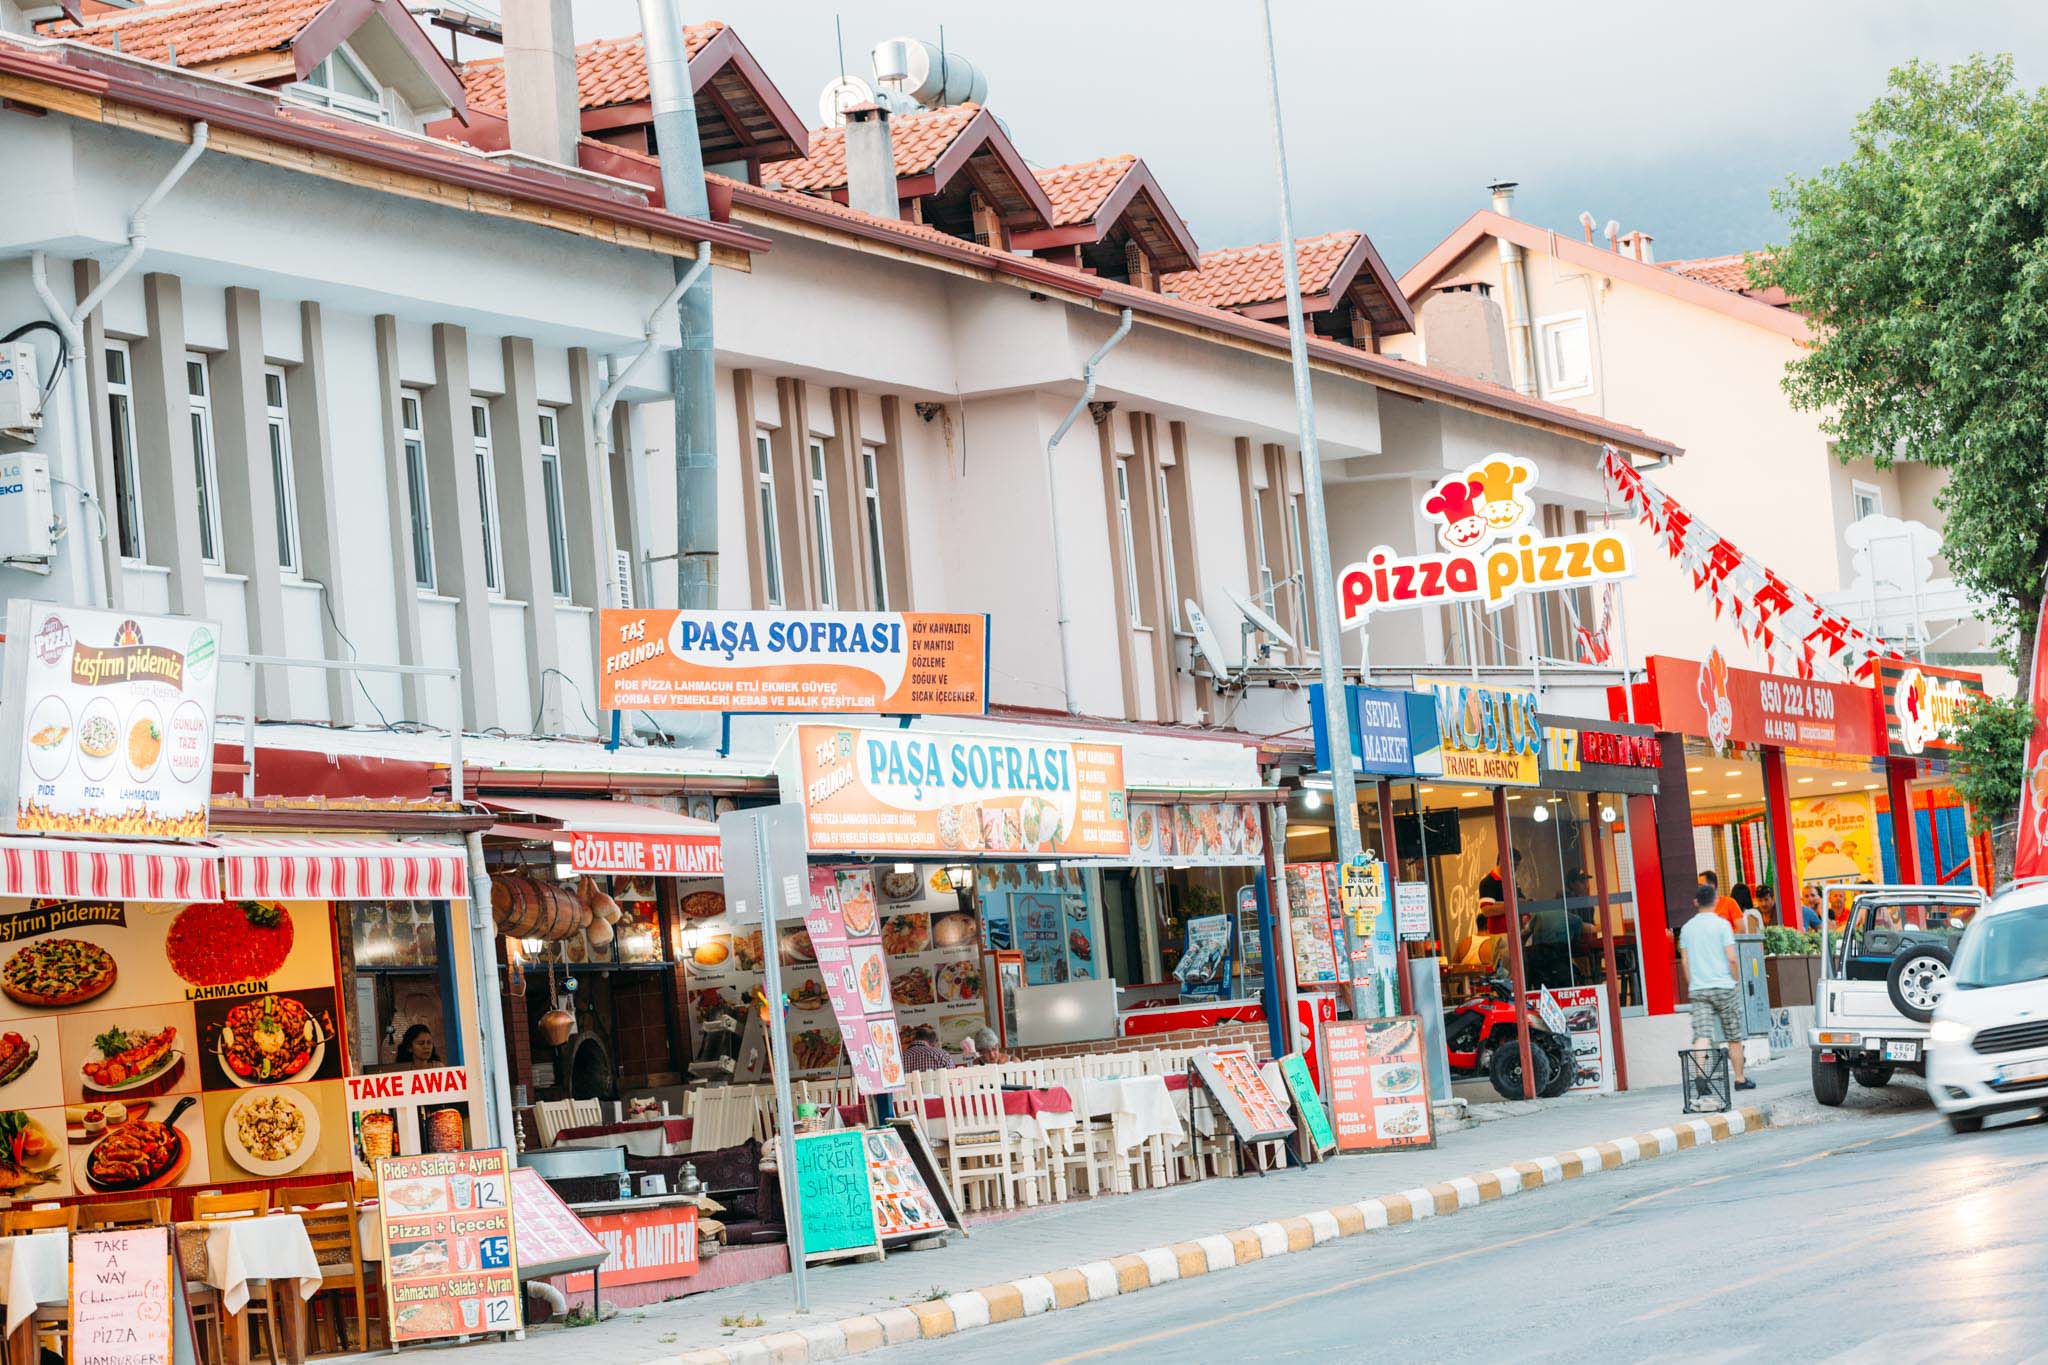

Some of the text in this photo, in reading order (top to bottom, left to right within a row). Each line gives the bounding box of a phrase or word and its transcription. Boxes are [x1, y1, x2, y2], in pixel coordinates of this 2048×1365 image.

[4, 467, 20, 477] LG
[1342, 534, 1626, 620] pizza pizza
[620, 619, 647, 644] TAŞ
[681, 620, 901, 661] PAŞA SOFRASI
[912, 622, 972, 635] KÖY KAHVALTISI
[606, 637, 666, 675] FIRINDA
[912, 639, 955, 652] EV MANTISI
[74, 651, 125, 686] taşfırın
[127, 648, 182, 681] pidemiz
[912, 655, 946, 669] GÖZLEME
[614, 679, 838, 696] PİDE PİZZA LAHMACUN ETLİ EKMEK GÜVEÇ
[912, 671, 949, 685] SOĞUK VE
[614, 693, 876, 709] ÇORBA EV YEMEKLERİ KEBAB VE BALIK ÇEŞİTLERİ
[911, 690, 934, 702] SICAK
[1760, 680, 1834, 720] 850 222 4 500
[1365, 700, 1402, 729] SEVDA
[1765, 718, 1774, 739] 44
[1774, 719, 1783, 740] 44
[1783, 721, 1796, 742] 500
[1363, 734, 1409, 765] MARKET
[868, 739, 1070, 800] PAŞA SOFRASI
[1444, 755, 1519, 779] TRAVEL AGENCY
[119, 788, 161, 801] LAHMACUN
[808, 762, 855, 807] FIRINDA
[1828, 814, 1865, 828] pizza
[574, 834, 645, 869] GÖZLEME
[651, 843, 672, 871] EV
[1345, 885, 1379, 898] TAXI
[50, 901, 121, 929] pidemiz
[185, 980, 269, 1001] LAHMACUN
[1558, 990, 1581, 999] RENT
[1579, 996, 1597, 1005] CAR
[1380, 1055, 1406, 1064] 12 TL
[349, 1070, 467, 1100] TAKE AWAY
[1399, 1096, 1410, 1104] TL
[1405, 1136, 1416, 1144] TL
[383, 1160, 408, 1180] Pide
[420, 1158, 457, 1176] Salata
[469, 1154, 501, 1175] Ayran
[797, 1147, 854, 1173] HICKEN
[474, 1181, 498, 1209] 12
[806, 1173, 862, 1198] SHISH
[388, 1220, 431, 1240] Pizza
[449, 1215, 507, 1237] İçecek
[94, 1239, 129, 1253] TAKE
[480, 1237, 509, 1257] 15
[625, 1234, 635, 1270] &
[635, 1222, 675, 1268] MANTI
[106, 1255, 118, 1268] A
[490, 1256, 503, 1265] TL
[97, 1271, 127, 1284] WAY
[393, 1280, 440, 1302] Lahmacun
[448, 1279, 477, 1297] Salata
[486, 1275, 513, 1296] Ayran
[487, 1299, 511, 1324] 12
